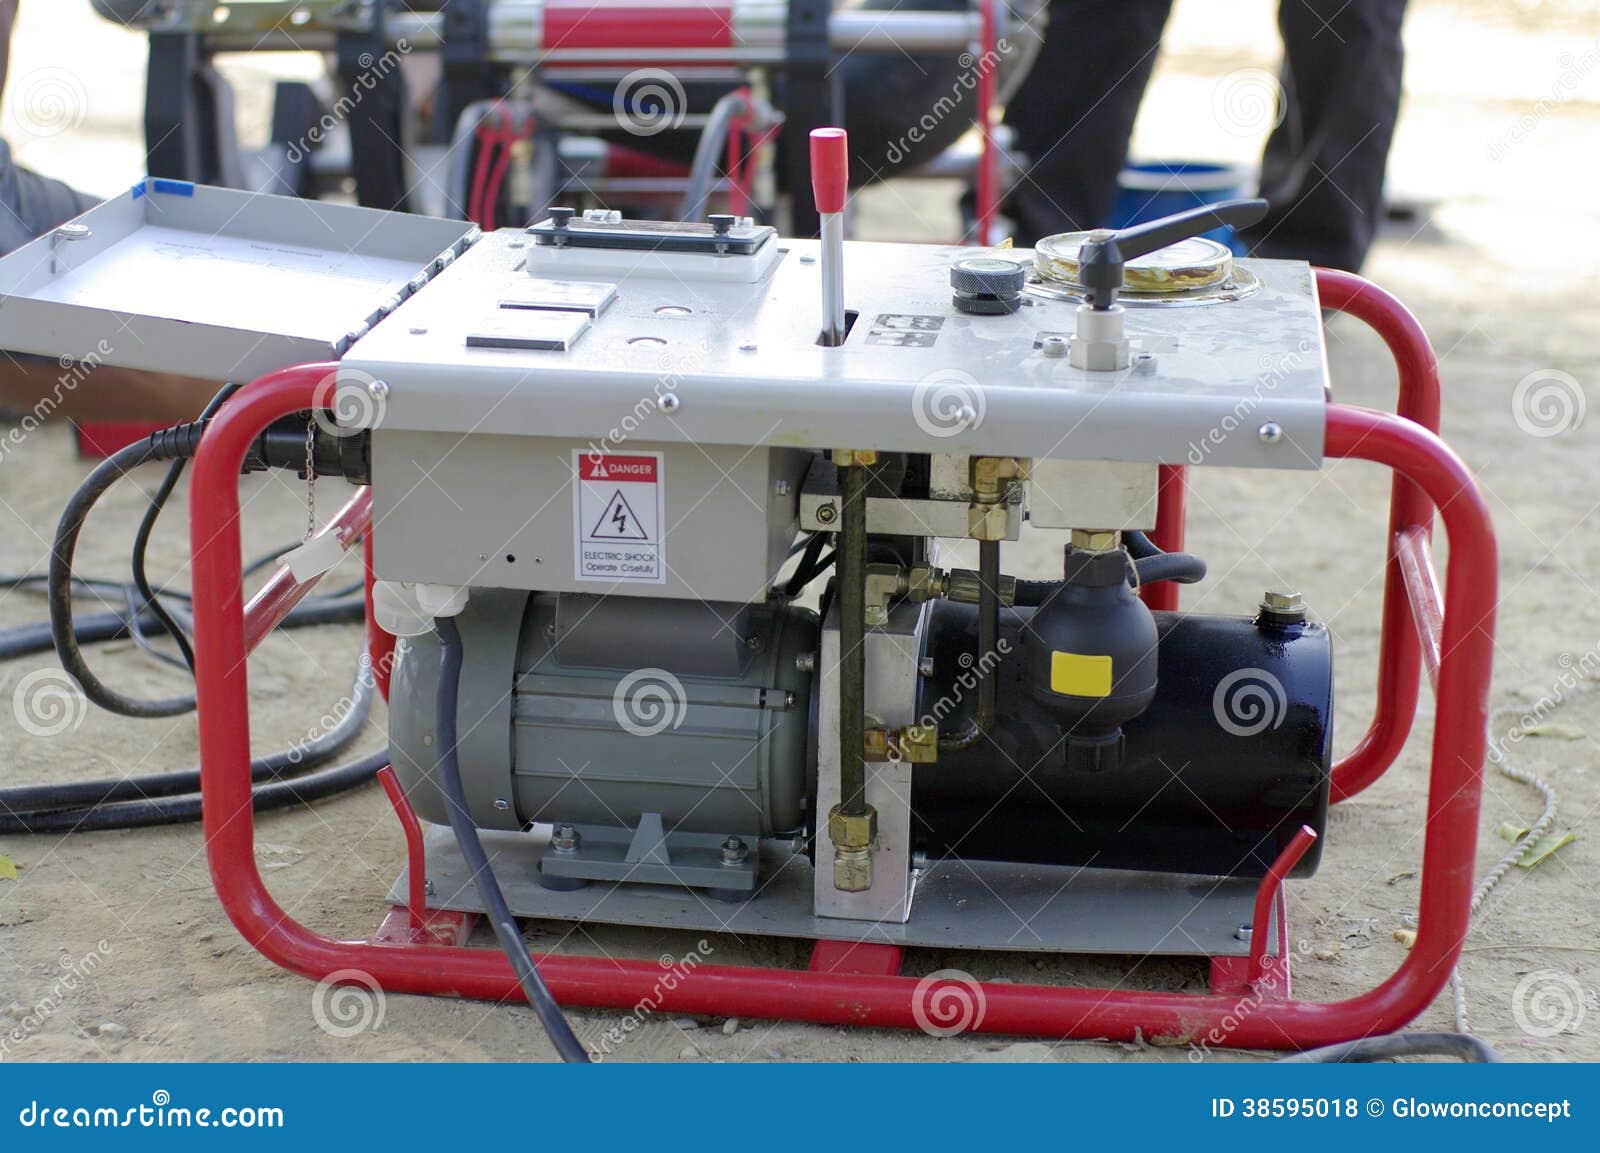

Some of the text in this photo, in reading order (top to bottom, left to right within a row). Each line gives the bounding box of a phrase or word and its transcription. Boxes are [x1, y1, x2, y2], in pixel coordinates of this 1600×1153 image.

[609, 463, 652, 474] DANGER
[584, 552, 656, 562] ELECTRIC SHOCK
[586, 562, 618, 572] Operate
